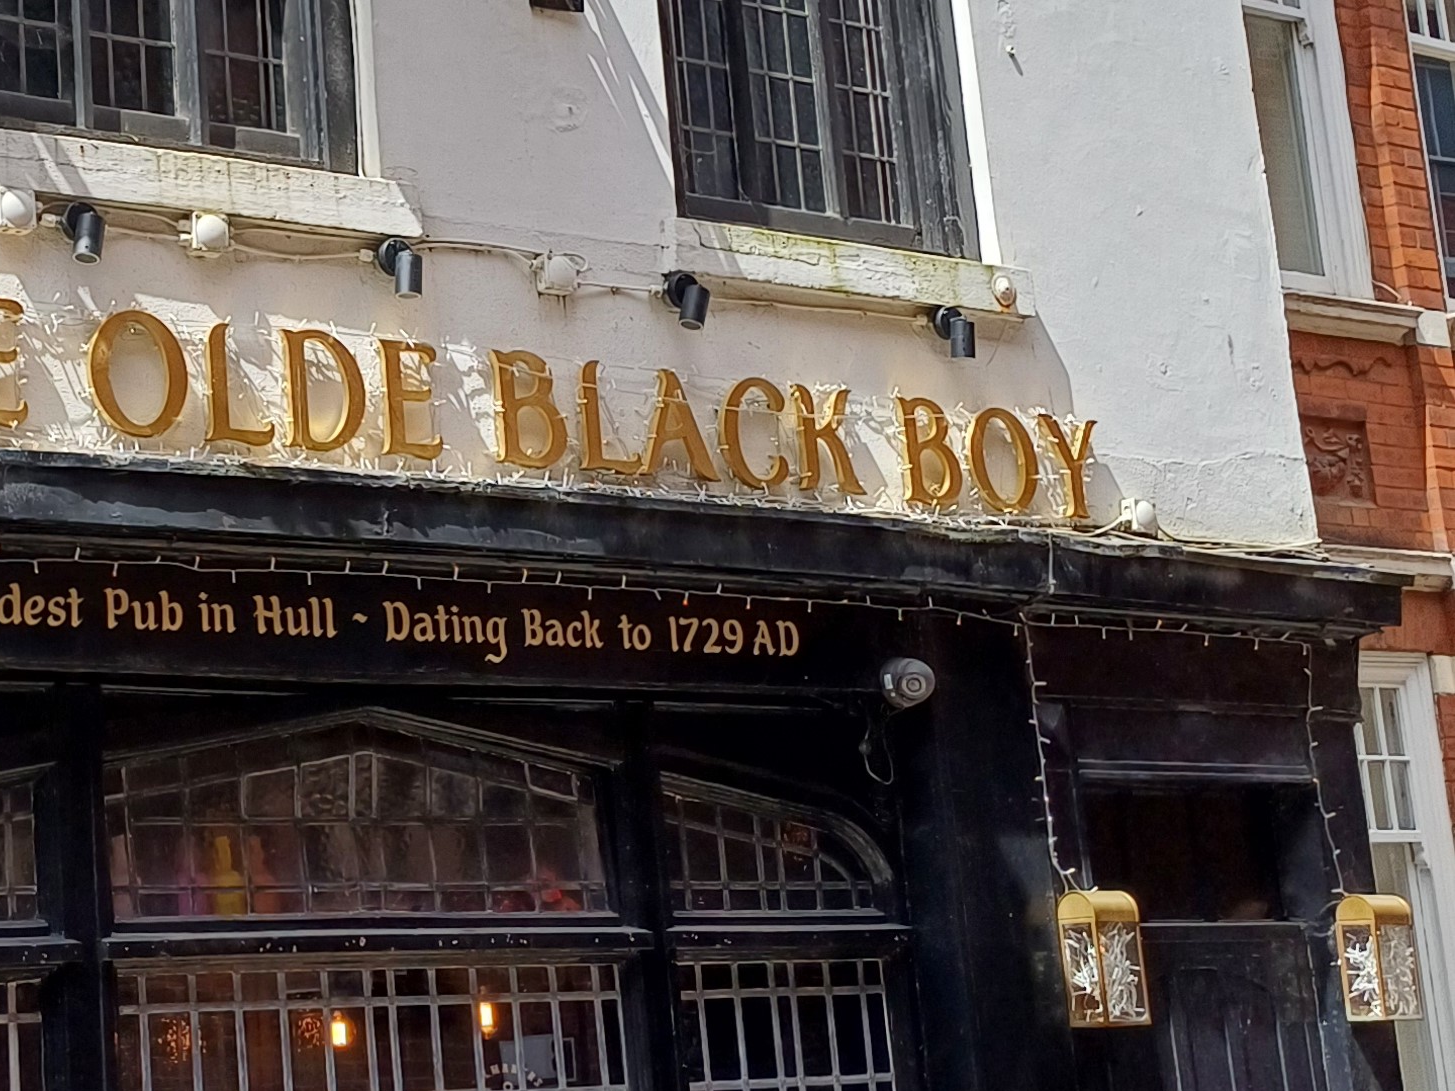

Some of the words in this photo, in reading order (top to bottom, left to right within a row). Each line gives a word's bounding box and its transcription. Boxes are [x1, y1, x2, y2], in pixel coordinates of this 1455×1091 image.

[89, 309, 444, 462] OLDE
[489, 349, 867, 496] BLACK
[895, 396, 1097, 521] BOY
[103, 587, 184, 632] Pub
[198, 591, 236, 634] in
[252, 595, 338, 639] Hull
[382, 600, 508, 664] Dating
[521, 608, 604, 649] Back
[617, 614, 652, 651] to
